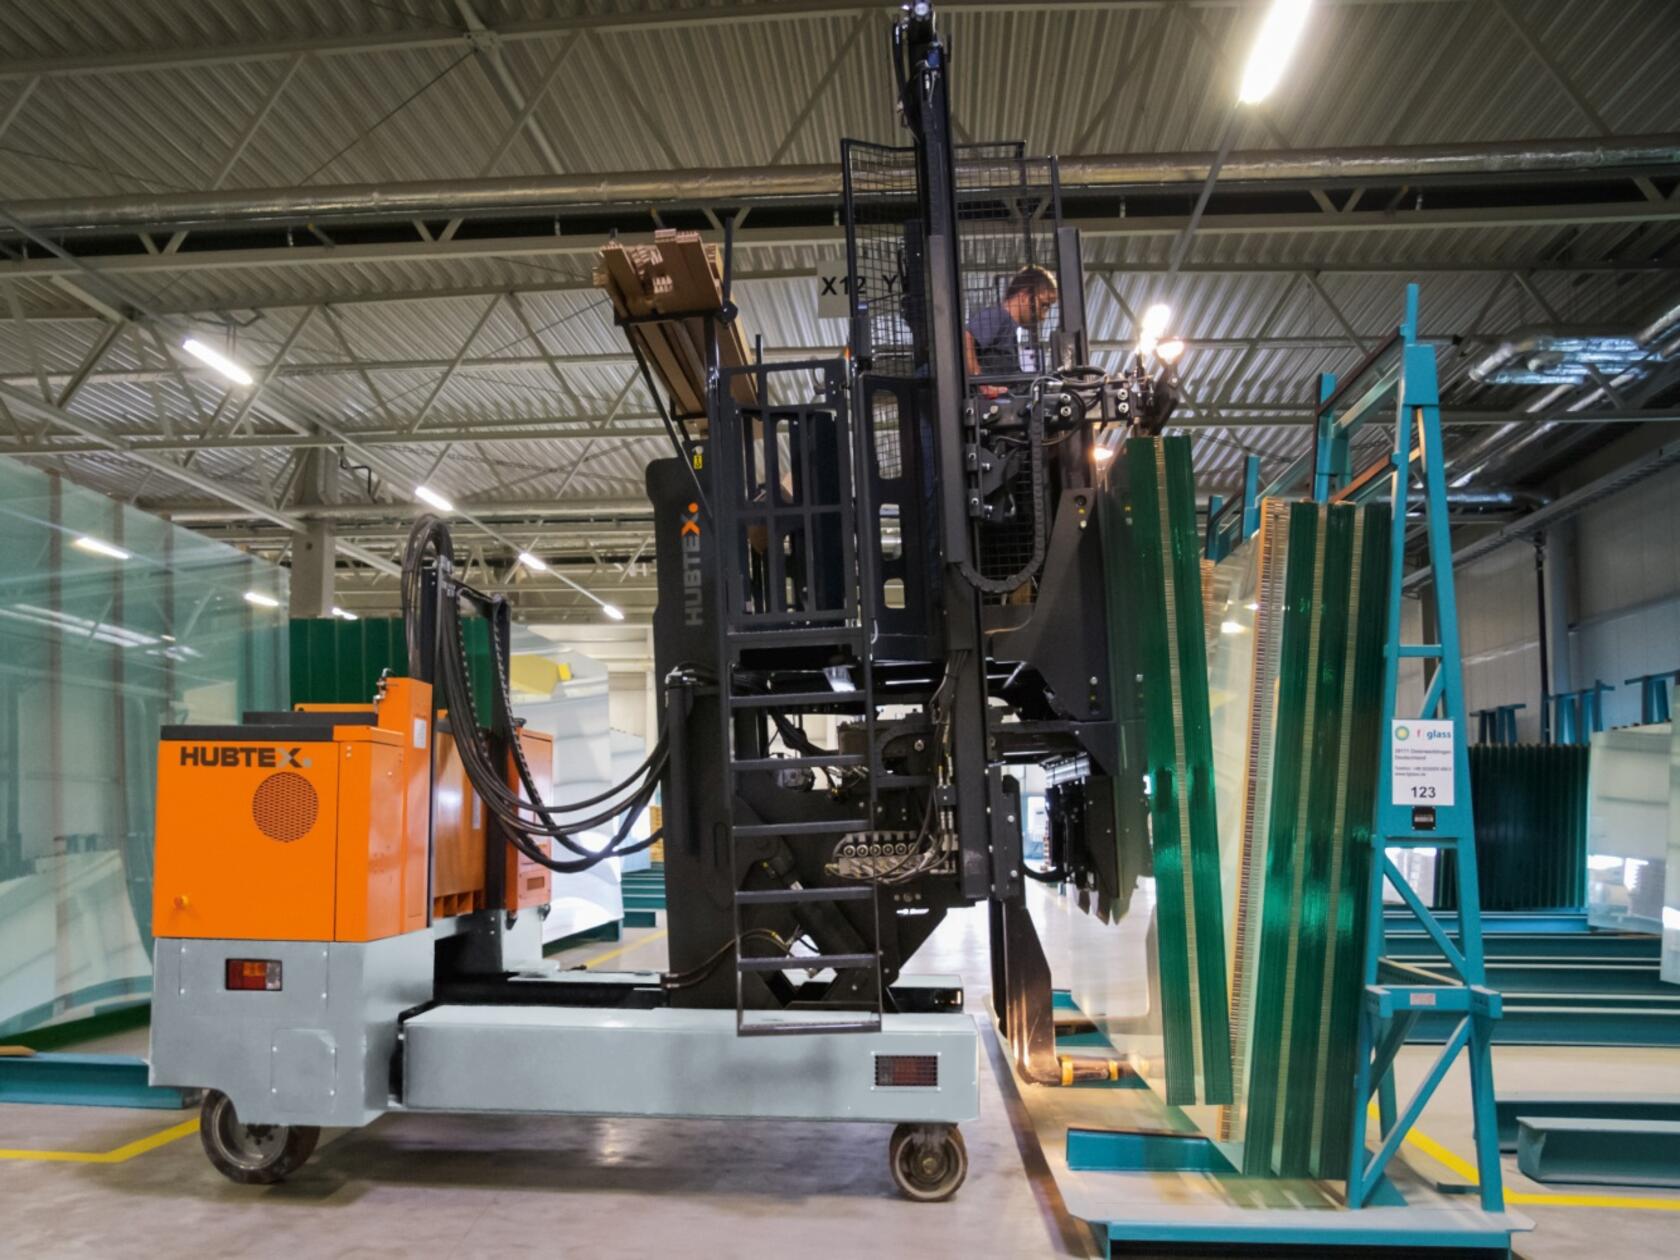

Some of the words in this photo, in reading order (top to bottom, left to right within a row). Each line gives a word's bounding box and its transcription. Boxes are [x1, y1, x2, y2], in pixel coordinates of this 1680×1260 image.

[821, 275, 867, 296] X12
[680, 503, 703, 626] HUBTEX
[1426, 729, 1452, 740] glass
[180, 746, 312, 768] HUBTEX
[1411, 786, 1436, 799] 123
